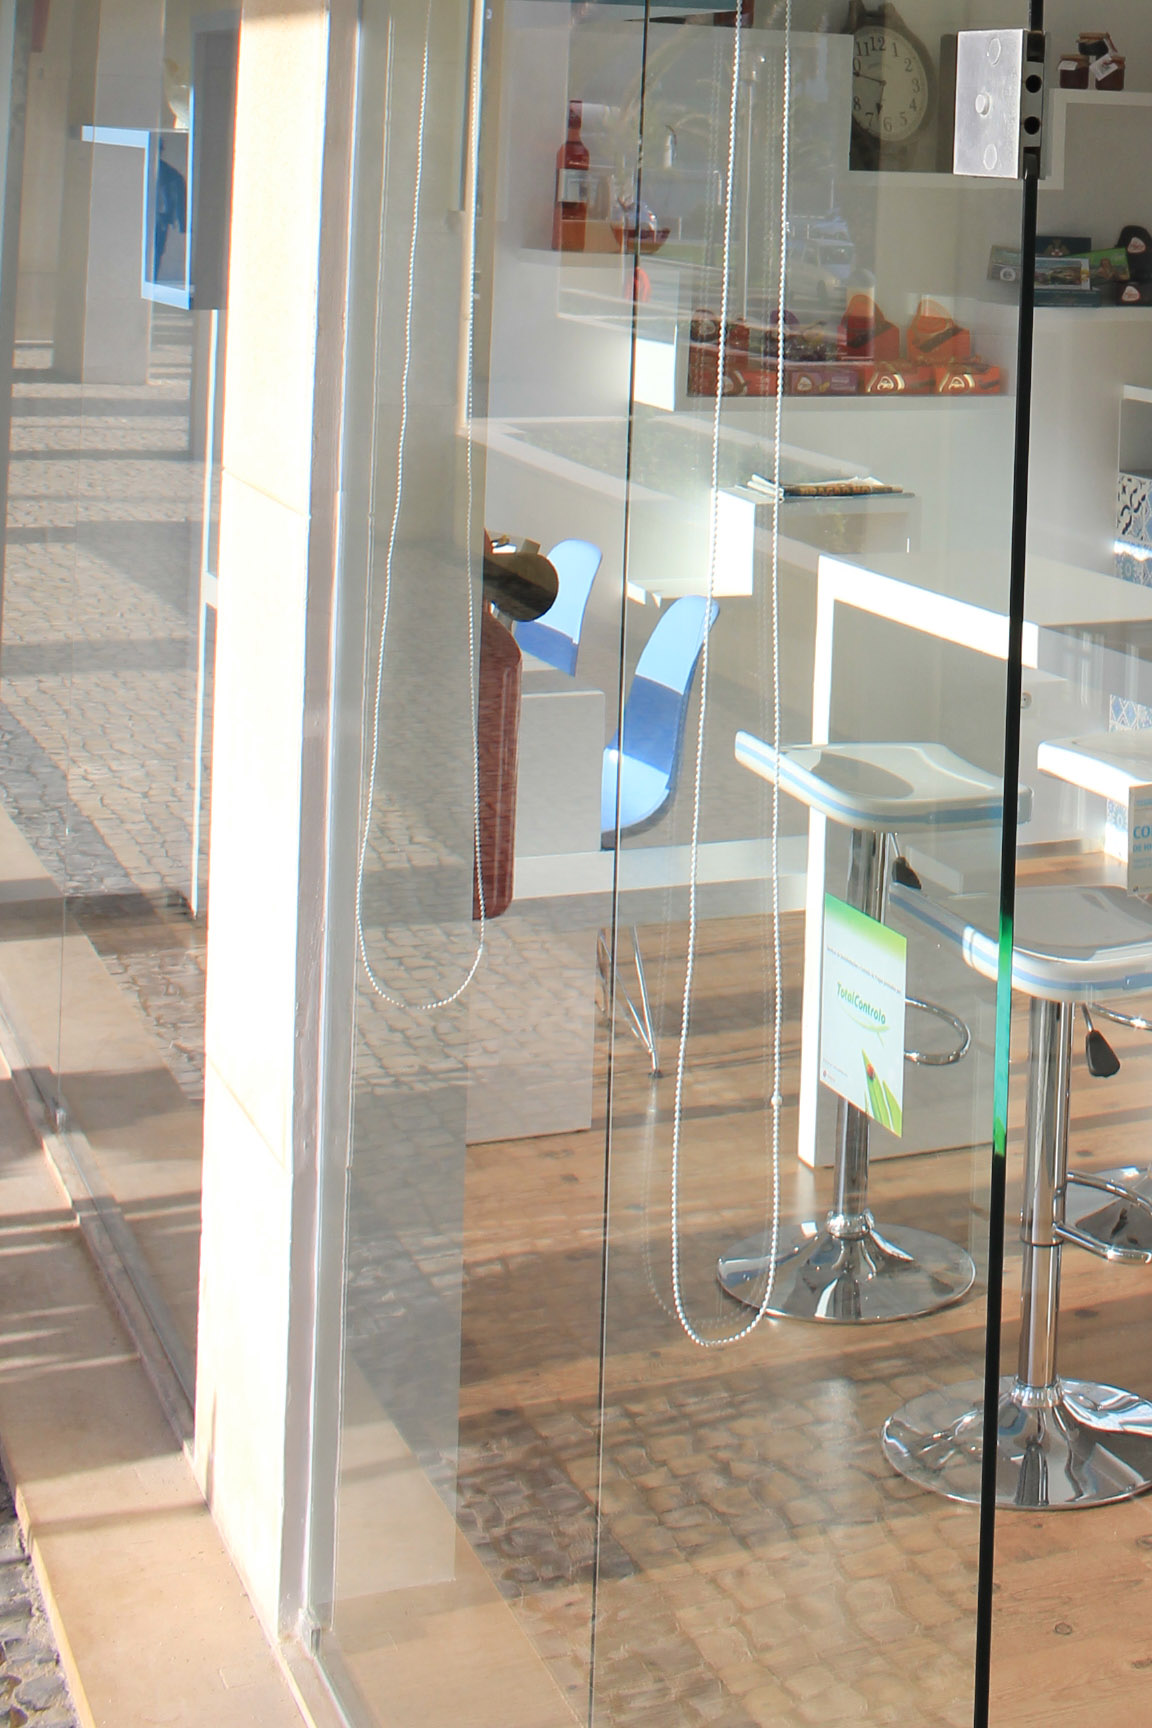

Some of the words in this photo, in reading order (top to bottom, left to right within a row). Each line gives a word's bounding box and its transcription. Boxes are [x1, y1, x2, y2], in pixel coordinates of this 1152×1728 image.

[855, 41, 870, 57] 11
[870, 36, 886, 51] 12
[893, 42, 900, 58] 1
[904, 58, 912, 73] 2
[912, 79, 920, 94] 3
[853, 96, 861, 111] 8
[909, 98, 917, 112] 4
[865, 112, 874, 127] 7
[883, 116, 893, 132] 6
[899, 111, 908, 127] 5
[836, 980, 887, 1025] TotalControlo
